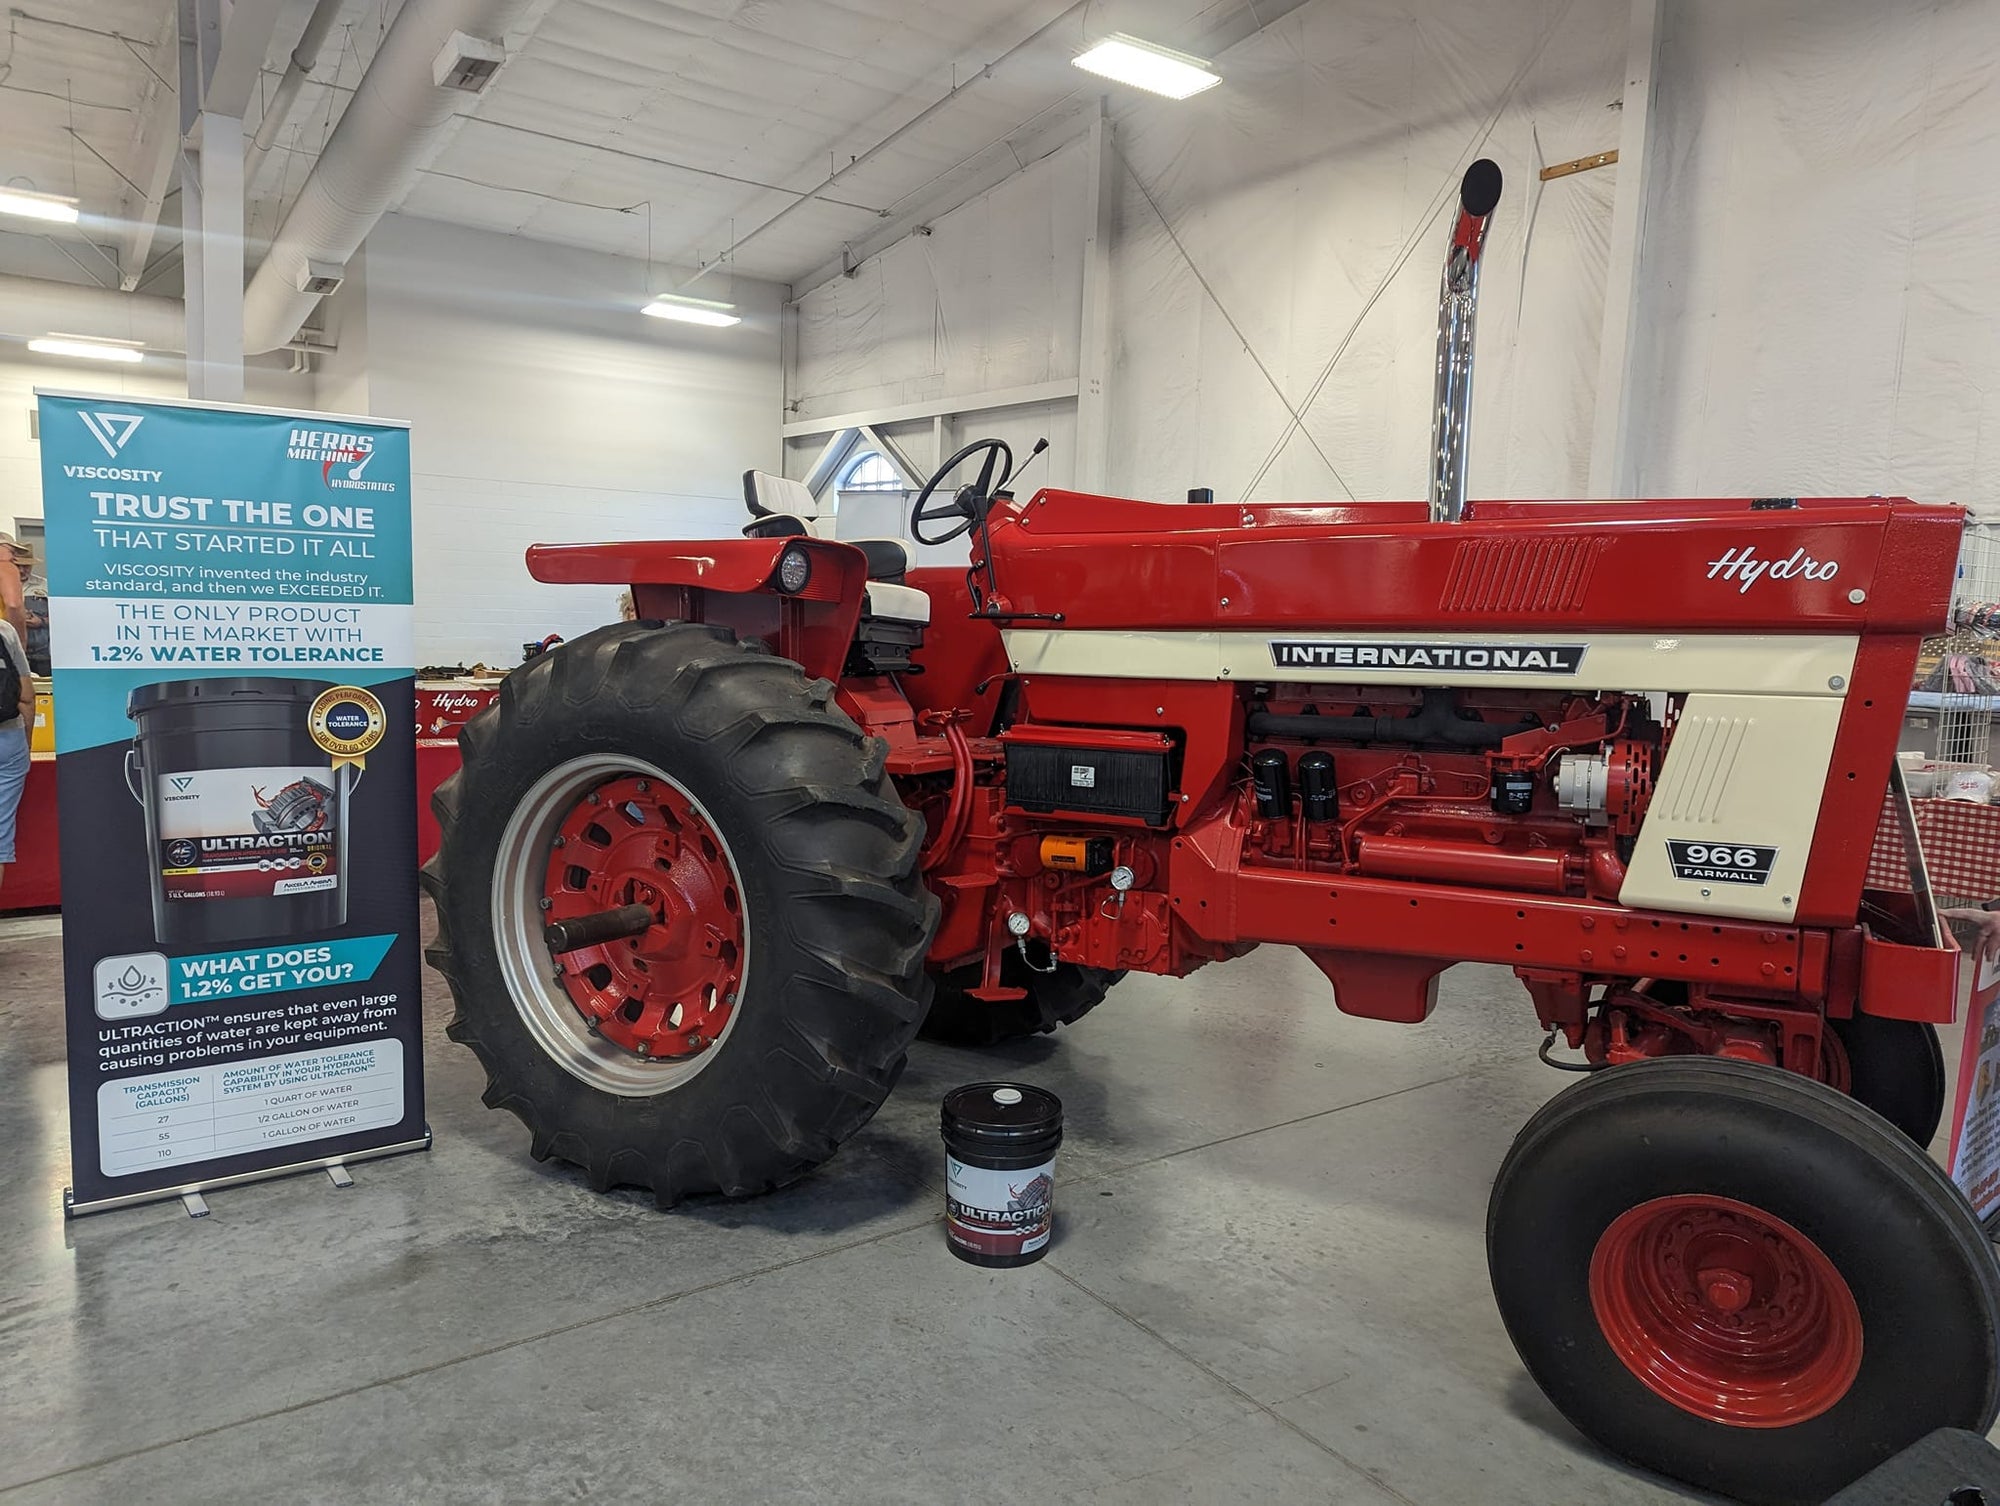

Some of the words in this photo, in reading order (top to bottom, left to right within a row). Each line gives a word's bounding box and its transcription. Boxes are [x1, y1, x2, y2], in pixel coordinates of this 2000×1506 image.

[289, 429, 374, 452] HERRS
[286, 448, 357, 463] MACHINE
[64, 465, 163, 483] VISCOSITY
[332, 480, 395, 492] HYDROSTATICS
[90, 492, 213, 521] TRUST
[223, 499, 292, 524] THE
[303, 504, 374, 529] ONE
[93, 528, 168, 549] THAT
[176, 532, 295, 554] STARTED
[303, 538, 323, 555] IT
[330, 539, 374, 558] ALL
[104, 563, 194, 578] VISCOSITY
[200, 566, 270, 580] invented
[275, 568, 301, 581] the
[306, 569, 368, 585] industry
[1707, 547, 1839, 594] Hydro
[86, 579, 167, 593] standard,
[172, 580, 202, 594] and
[208, 581, 246, 595] then
[251, 585, 275, 595] we
[279, 583, 364, 597] EXCEEDED
[368, 586, 384, 598] IT.
[116, 604, 164, 620] THE
[174, 606, 240, 621] ONLY
[249, 607, 361, 623] PRODUCT
[117, 624, 142, 640] IN
[150, 625, 195, 641] THE
[204, 626, 299, 642] MARKET
[305, 628, 361, 642] WITH
[92, 646, 143, 662] 1.2%
[150, 647, 240, 661] WATER
[249, 648, 383, 662] TOLERANCE
[1281, 647, 1569, 668] INTERNATIONAL
[316, 695, 335, 718] LEADING
[336, 692, 378, 716] PERFORMANCE
[432, 693, 478, 711] Hydro
[318, 732, 329, 743] FOR
[330, 742, 349, 750] OVER
[359, 731, 377, 747] YEARS
[202, 831, 332, 850] ULTRACTION
[1686, 847, 1758, 866] 966
[1684, 868, 1758, 881] FARMALL
[181, 956, 260, 978] WHAT
[267, 947, 331, 968] DOES
[181, 978, 232, 998] 1.2%
[240, 971, 287, 991] GET
[292, 964, 353, 983] YOU?
[223, 1006, 284, 1025] ensures
[288, 1004, 319, 1017] that
[323, 999, 357, 1011] even
[361, 993, 397, 1008] large
[99, 1035, 182, 1058] quantities
[187, 1031, 203, 1045] of
[205, 1027, 251, 1042] water
[255, 1022, 280, 1034] are
[284, 1016, 317, 1033] kept
[321, 1013, 359, 1027] away
[363, 1006, 397, 1019] from
[99, 1053, 164, 1072] causing
[169, 1043, 244, 1063] problems
[249, 1039, 262, 1051] in
[266, 1035, 300, 1051] your
[303, 1021, 387, 1042] equipment.
[223, 1066, 267, 1079] AMOUNT
[269, 1064, 281, 1072] OF
[284, 1058, 317, 1070] WATER
[321, 1049, 375, 1065] TOLERANCE
[223, 1074, 280, 1087] CAPABILITY
[293, 1066, 321, 1077] YOUR
[323, 1057, 375, 1073] HYDRAULIC
[123, 1076, 200, 1094] TRANSMISSION
[137, 1087, 188, 1101] CAPACITY
[224, 1083, 261, 1095] SYSTEM
[264, 1081, 277, 1090] BY
[279, 1075, 308, 1087] USING
[270, 1094, 302, 1105] QUART
[305, 1090, 318, 1099] OF
[321, 1085, 352, 1097] WATER
[135, 1093, 190, 1109] (GALLONS)
[157, 1115, 169, 1124] 27
[258, 1114, 270, 1124] 1/2
[271, 1109, 309, 1122] GALLON
[312, 1108, 324, 1116] OF
[326, 1099, 359, 1112] WATER
[268, 1125, 306, 1139] GALLON
[308, 1122, 322, 1130] OF
[323, 1116, 355, 1128] WATER
[158, 1149, 171, 1158] 110
[961, 1202, 1050, 1222] ULTRACTION
